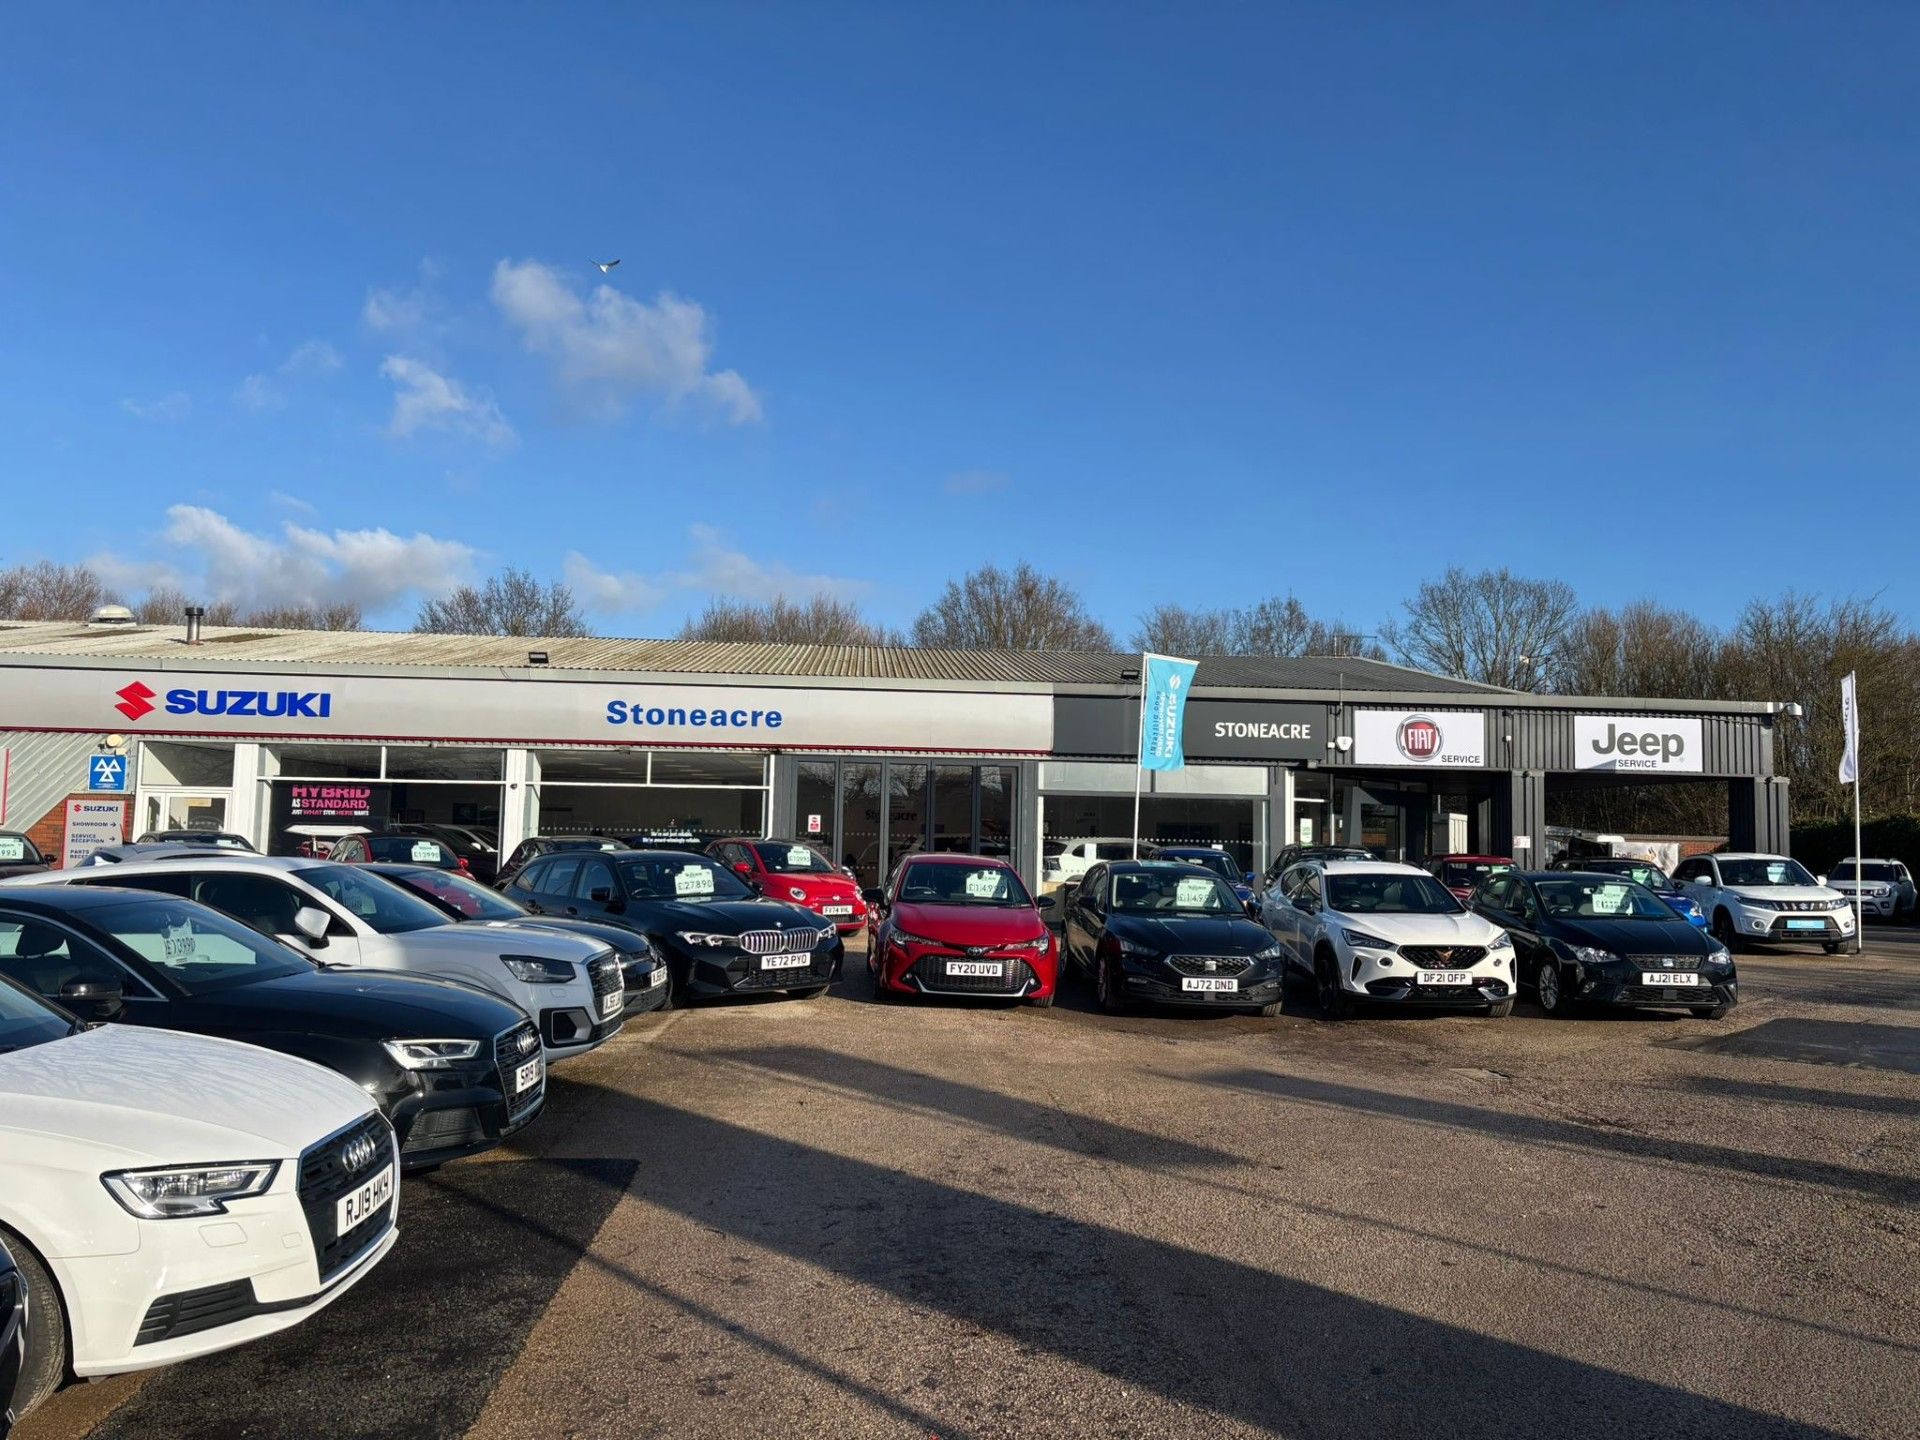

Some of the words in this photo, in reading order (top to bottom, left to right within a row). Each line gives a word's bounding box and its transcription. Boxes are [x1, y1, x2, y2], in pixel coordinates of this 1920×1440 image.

[165, 689, 331, 718] SUZUKI
[606, 700, 783, 728] Stoneacre
[1165, 692, 1178, 758] SUZUKI
[1214, 722, 1311, 739] STONEACRE
[1407, 728, 1434, 750] FIAT
[1592, 723, 1685, 763] Jeep
[1441, 754, 1481, 764] SERVICE
[1618, 759, 1658, 768] SERVICE
[292, 784, 371, 798] HYBRID
[83, 805, 119, 813] SUZUKI
[291, 799, 301, 808] AS
[302, 799, 370, 810] STANDARD,
[765, 956, 789, 967] YE72
[950, 964, 977, 974] FY20
[979, 965, 998, 975] UVD
[1423, 973, 1445, 983] DF21
[1649, 974, 1670, 983] AJ21
[1673, 974, 1691, 984] ELX
[1186, 979, 1212, 990] AJ72
[1214, 980, 1233, 990] DND
[346, 1186, 371, 1227] RJ19
